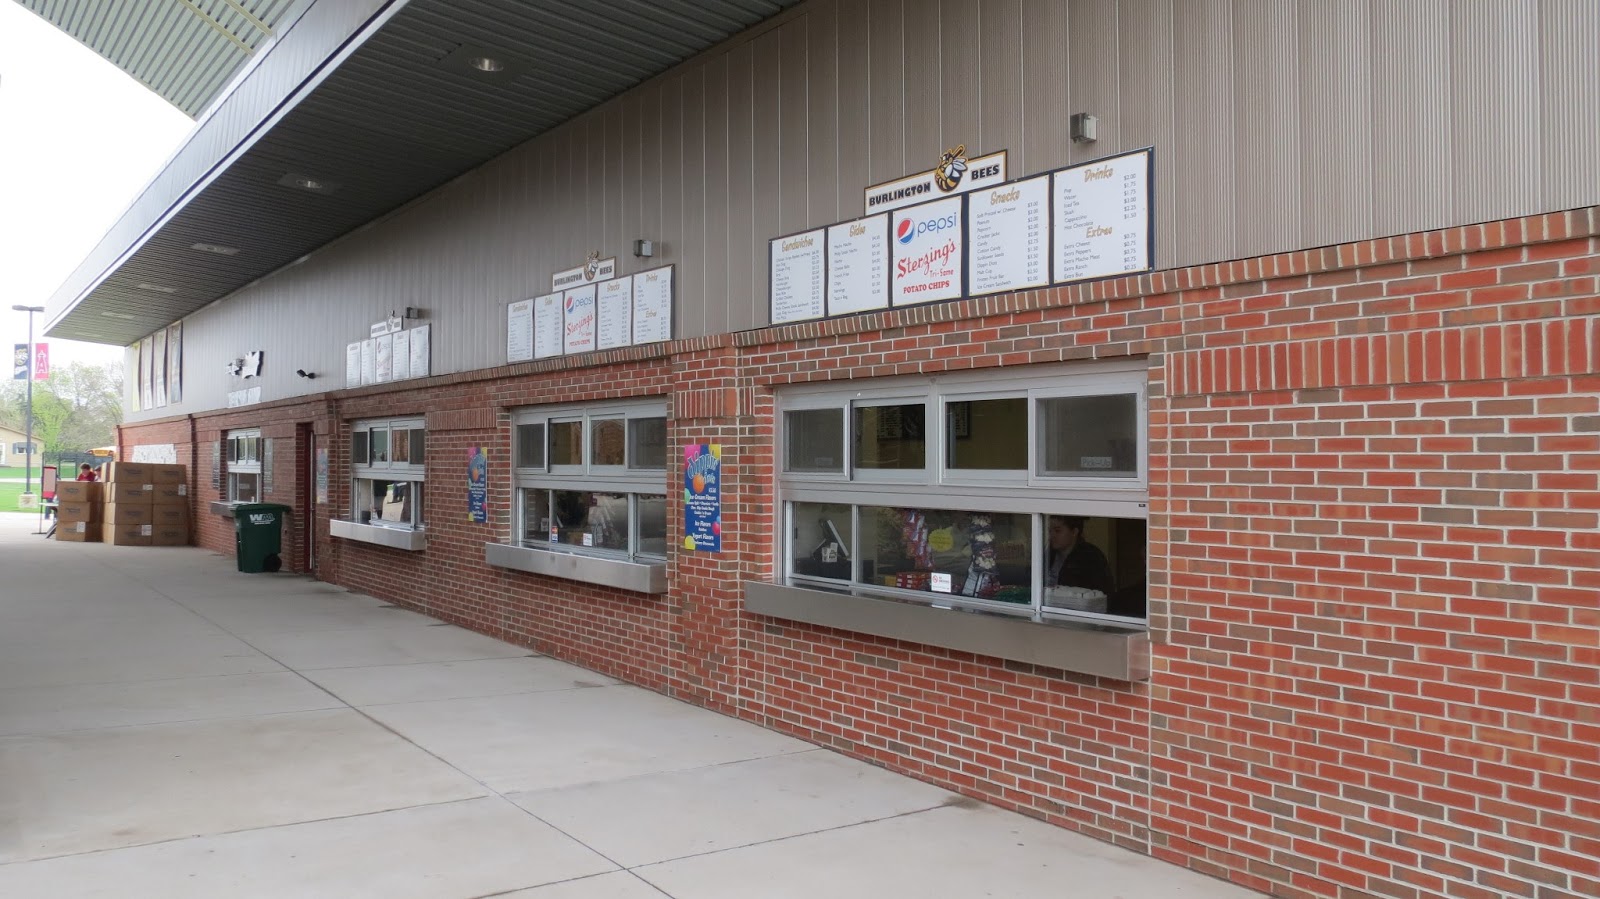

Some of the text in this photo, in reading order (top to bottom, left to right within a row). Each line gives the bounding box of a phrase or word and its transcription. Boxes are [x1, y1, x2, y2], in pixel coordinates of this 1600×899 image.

[1084, 164, 1114, 183] Drinks
[869, 164, 1000, 207] BURLINGTON BEES
[990, 187, 1020, 206] Snacks
[917, 212, 957, 237] pepsi
[1086, 225, 1112, 238] Extras
[897, 238, 956, 280] Sterzing's
[903, 280, 950, 294] POTATO CHIPS
[575, 294, 593, 308] pepsi
